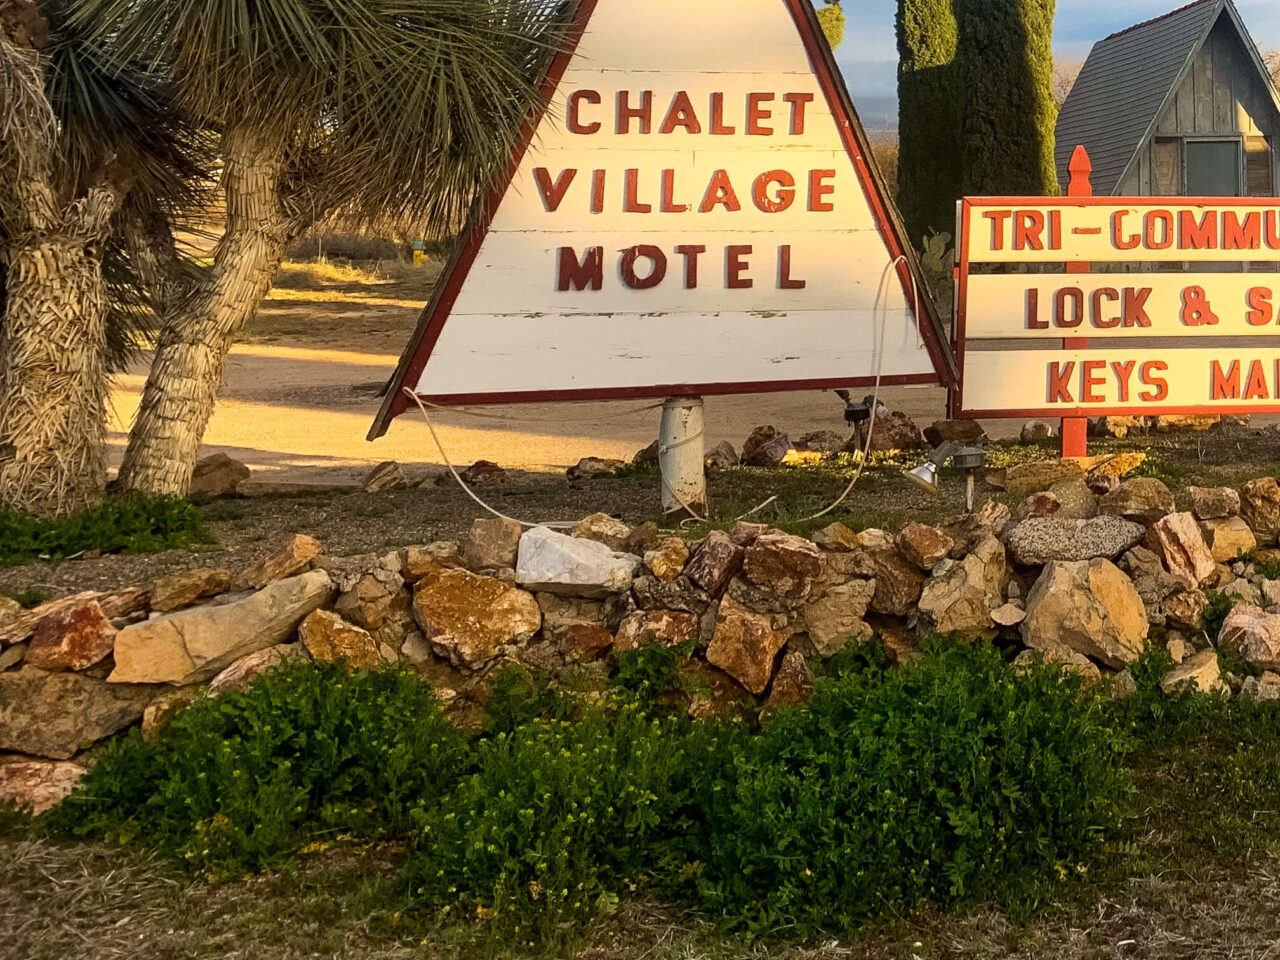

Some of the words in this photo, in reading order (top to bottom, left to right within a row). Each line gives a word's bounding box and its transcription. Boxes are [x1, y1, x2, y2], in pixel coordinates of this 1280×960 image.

[568, 90, 814, 135] CHALET
[534, 167, 836, 213] VILLAGE
[557, 244, 806, 290] MOTEL
[1026, 287, 1153, 330] LOCK
[1181, 285, 1219, 326] &
[1047, 360, 1169, 403] KEYS
